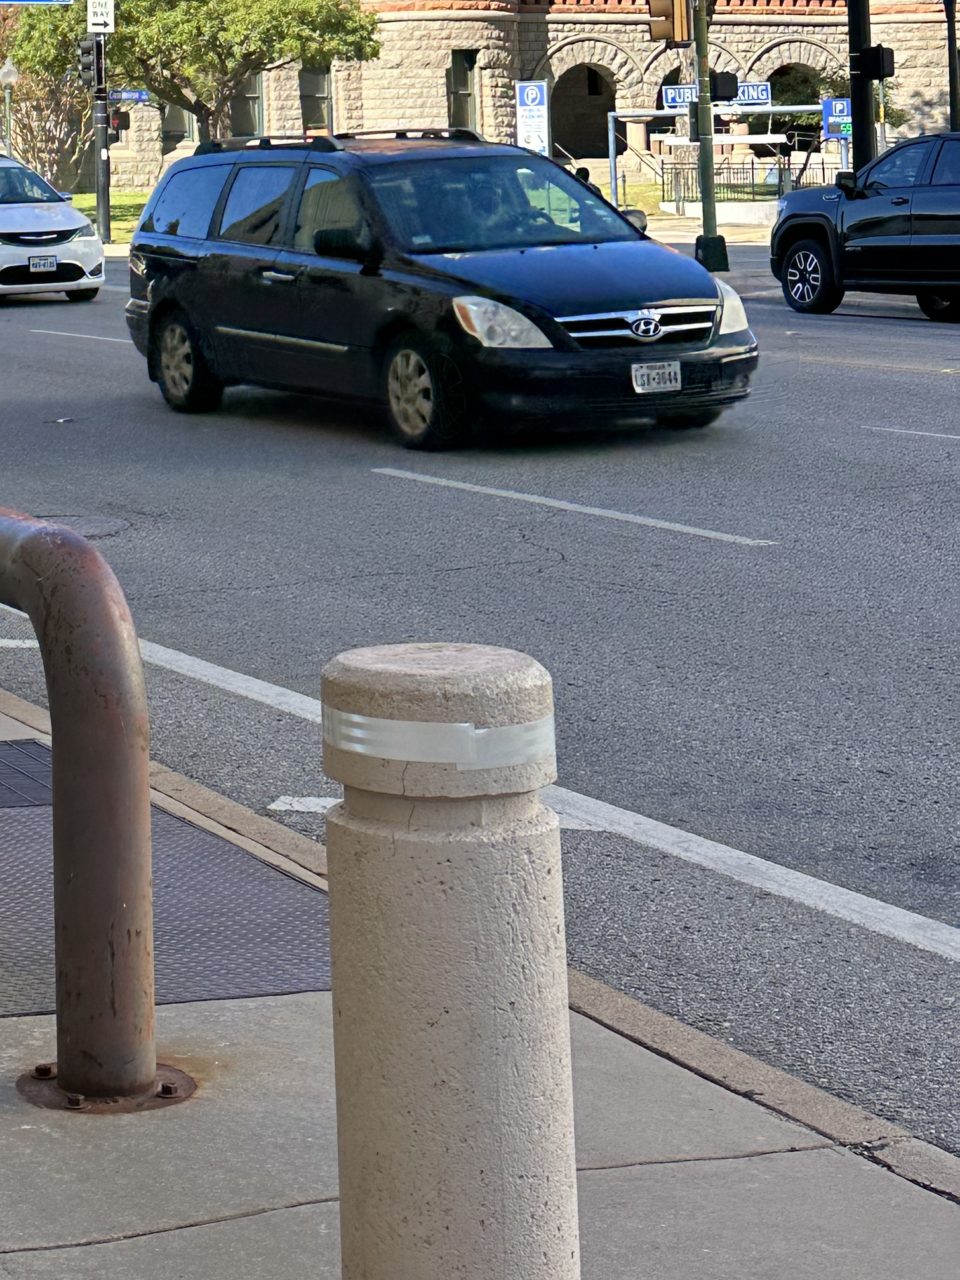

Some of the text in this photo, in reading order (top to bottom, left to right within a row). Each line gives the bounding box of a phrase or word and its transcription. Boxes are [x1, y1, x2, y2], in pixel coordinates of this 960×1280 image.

[91, 1, 108, 10] ONE
[92, 11, 110, 19] WAY
[666, 85, 768, 103] PUBL KING
